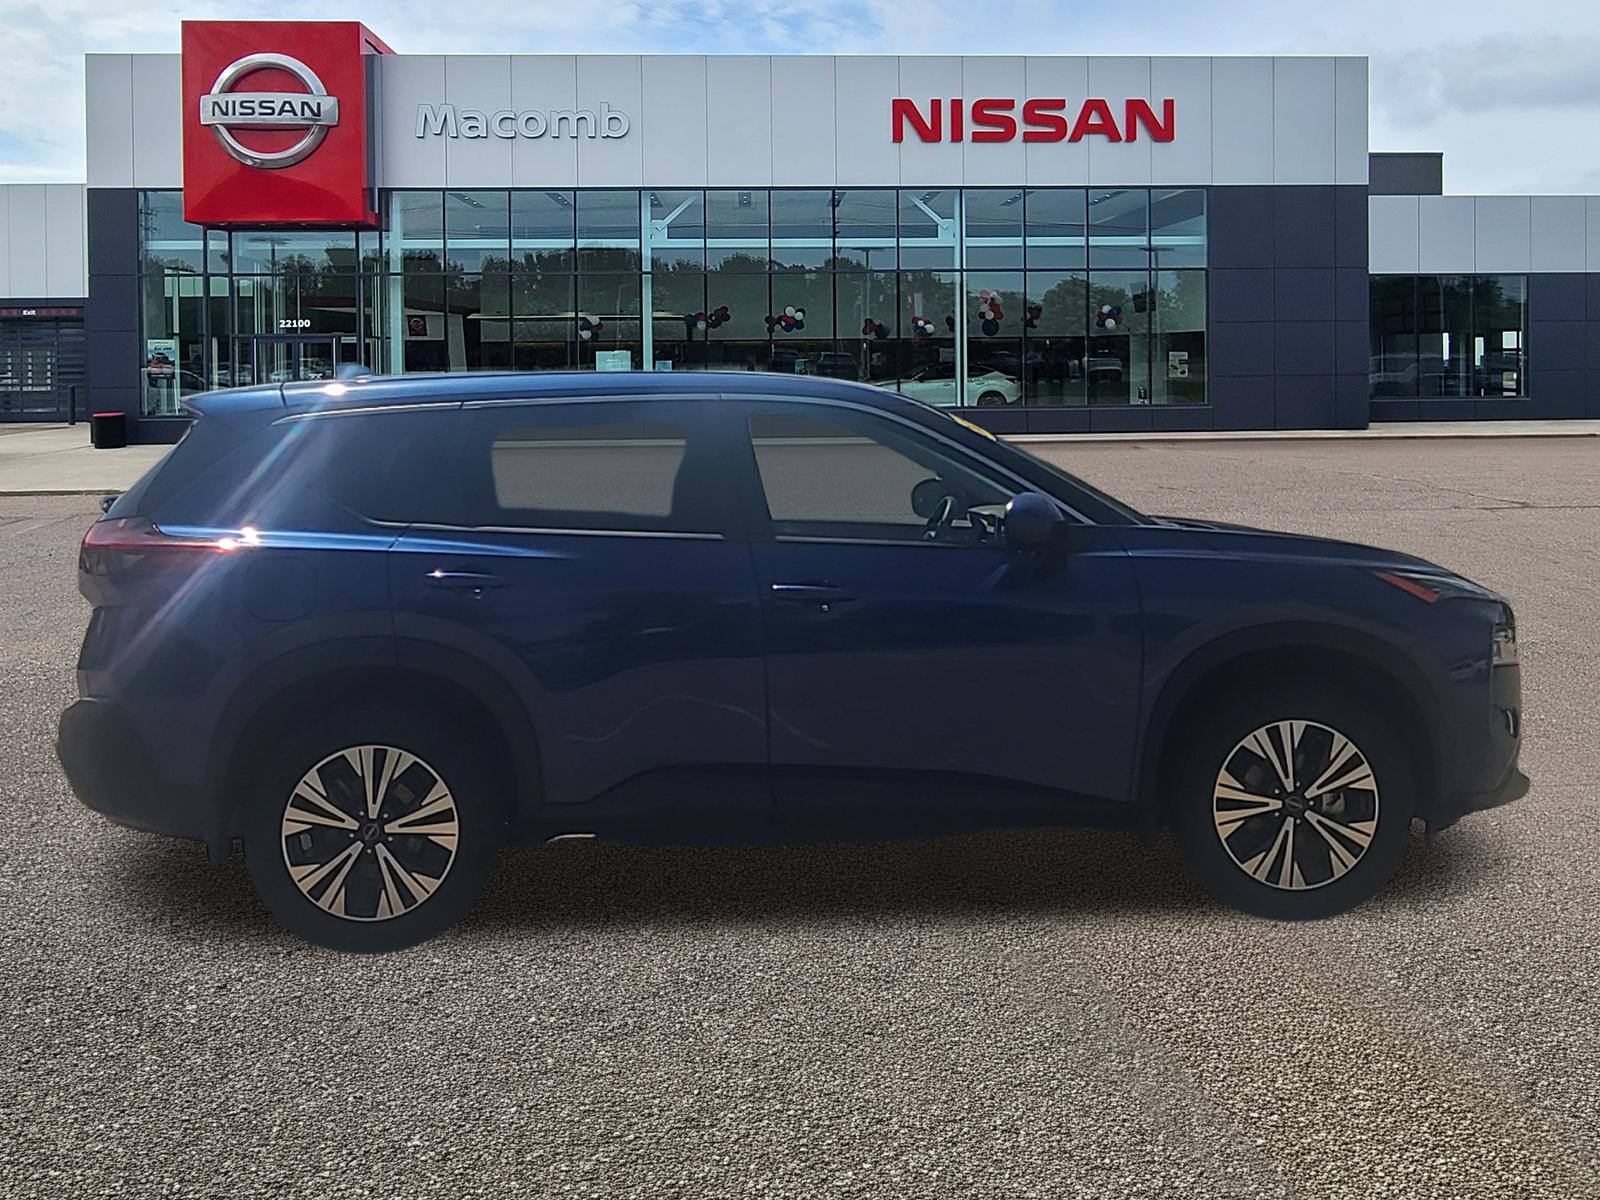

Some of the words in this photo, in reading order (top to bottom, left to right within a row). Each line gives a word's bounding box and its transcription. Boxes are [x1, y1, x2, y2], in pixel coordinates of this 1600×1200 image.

[212, 100, 321, 117] NISSAN
[416, 101, 630, 139] Macomb
[892, 98, 1175, 142] NISSAN
[279, 319, 311, 328] 22100
